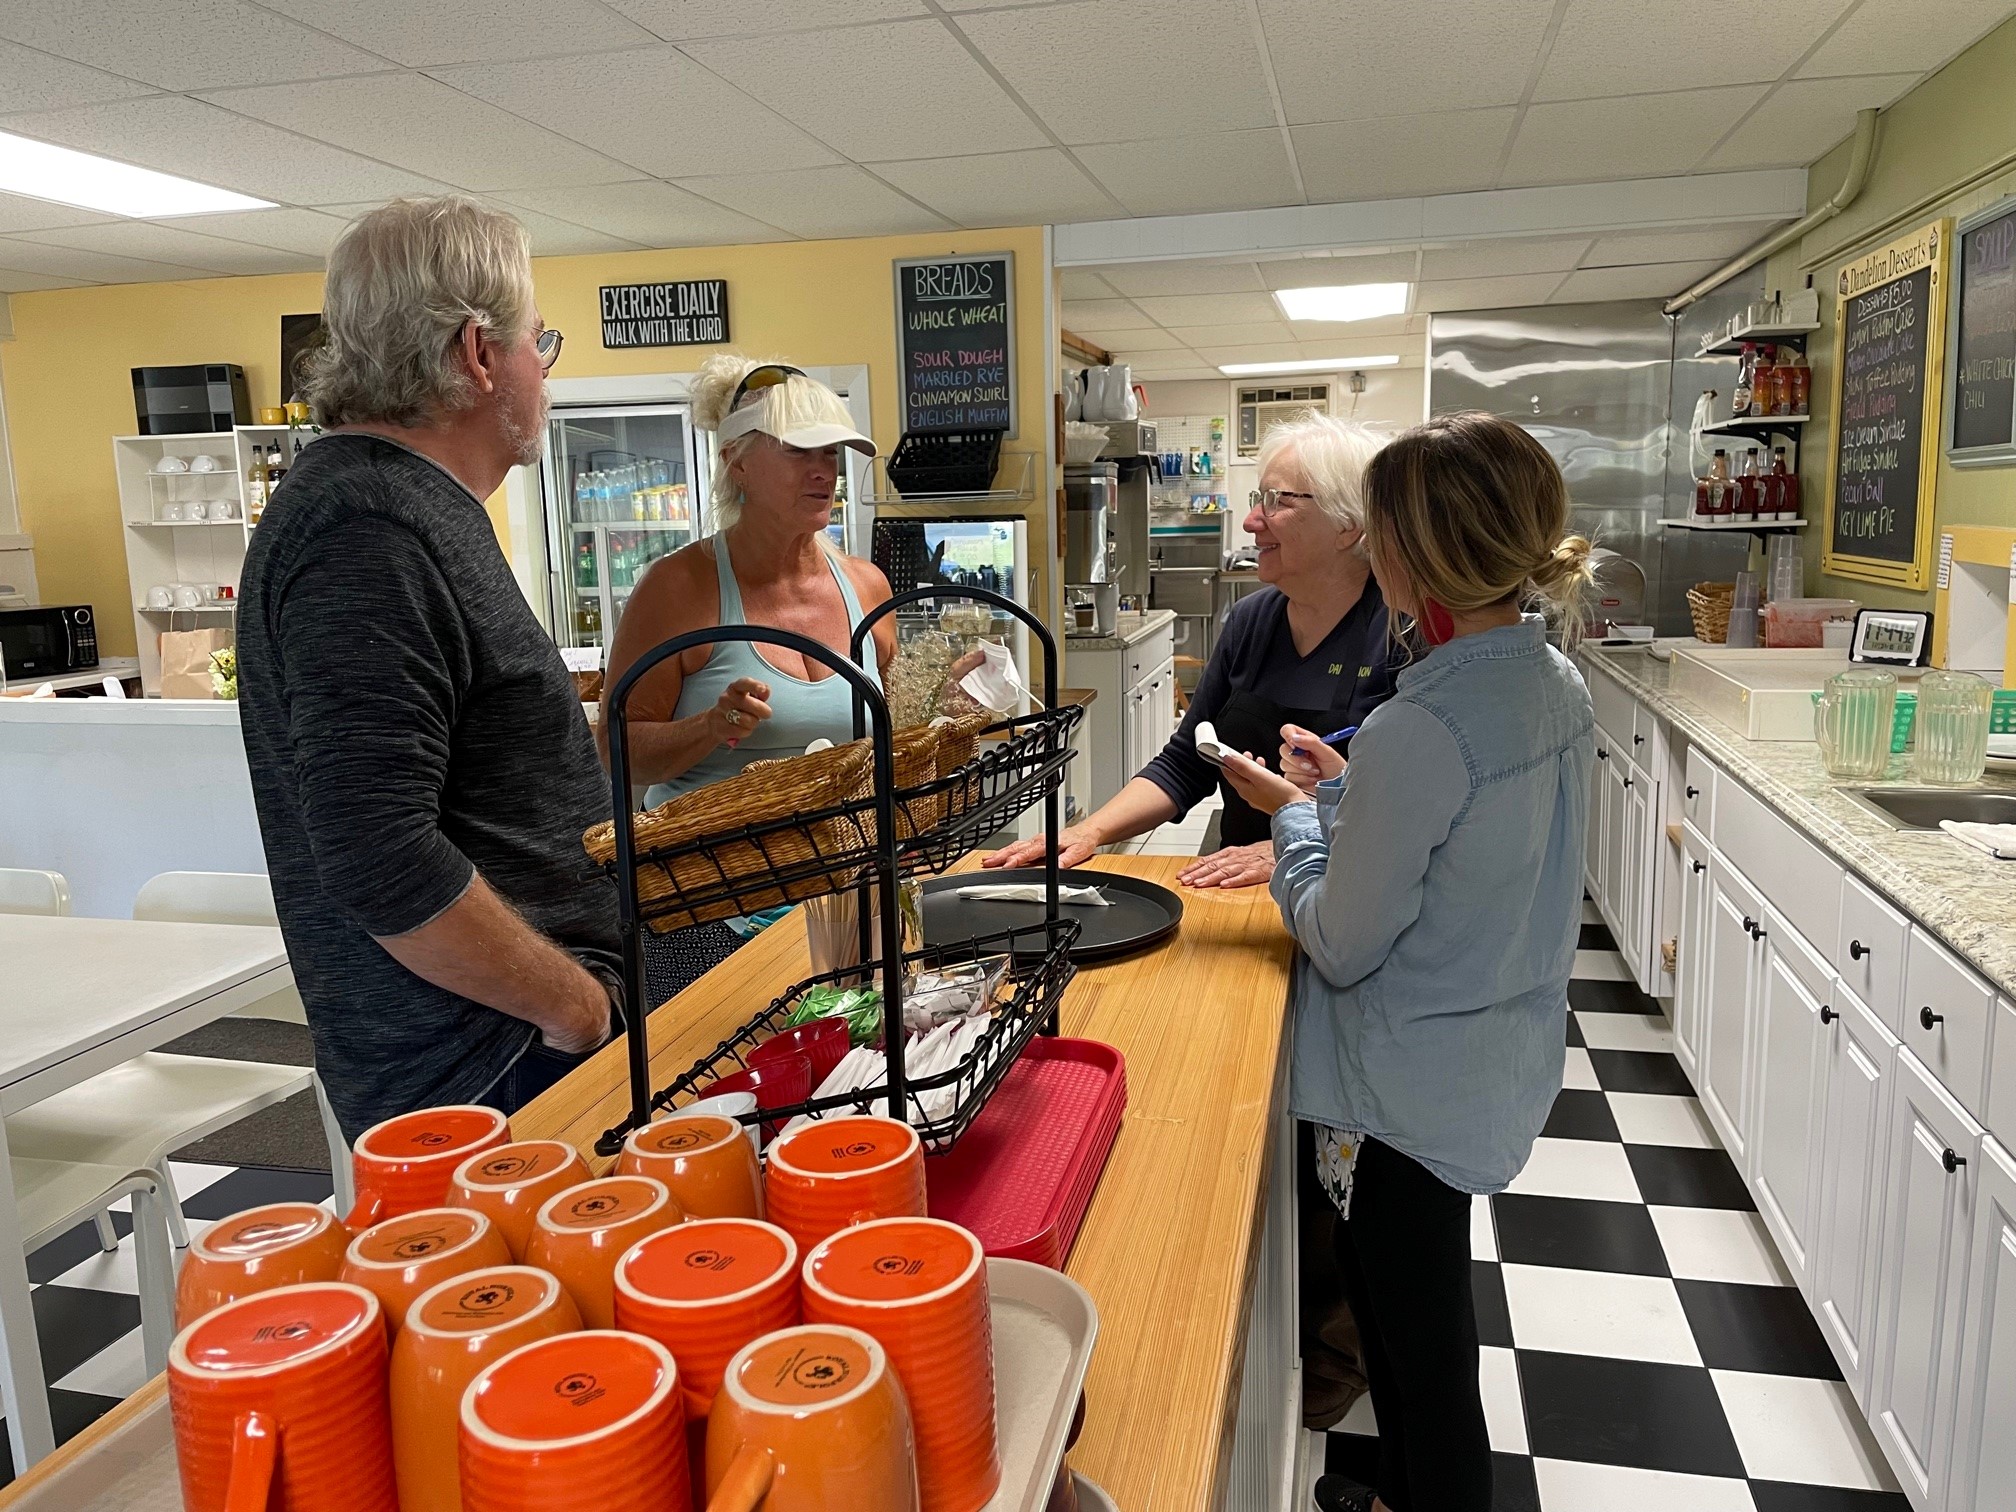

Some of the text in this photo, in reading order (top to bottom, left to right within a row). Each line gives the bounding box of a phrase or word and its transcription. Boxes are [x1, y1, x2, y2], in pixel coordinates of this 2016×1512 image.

[914, 263, 993, 296] BREADS
[1849, 239, 1926, 294] Dandelion Desserts
[601, 281, 720, 320] EXERCISE DAILY
[909, 302, 1006, 331] WHOLE WHEAT
[1894, 306, 1916, 334] Cake
[603, 316, 722, 346] WALK WITH THE LORD
[1895, 331, 1915, 356] Cake
[913, 348, 1003, 368] SOUR DOUGH
[1965, 358, 1993, 383] WHITE
[913, 367, 1004, 389] MARBLED RYE
[1866, 366, 1891, 394] Toffee
[909, 385, 1009, 407] CINNAMON SWIRL
[1963, 389, 1985, 410] CHILI
[910, 406, 1008, 428] ENGLISH MUFFIN
[1842, 429, 1855, 449] Ice
[1841, 476, 1884, 504] Pecan Ball
[1840, 505, 1896, 540] KEY LIME PIE
